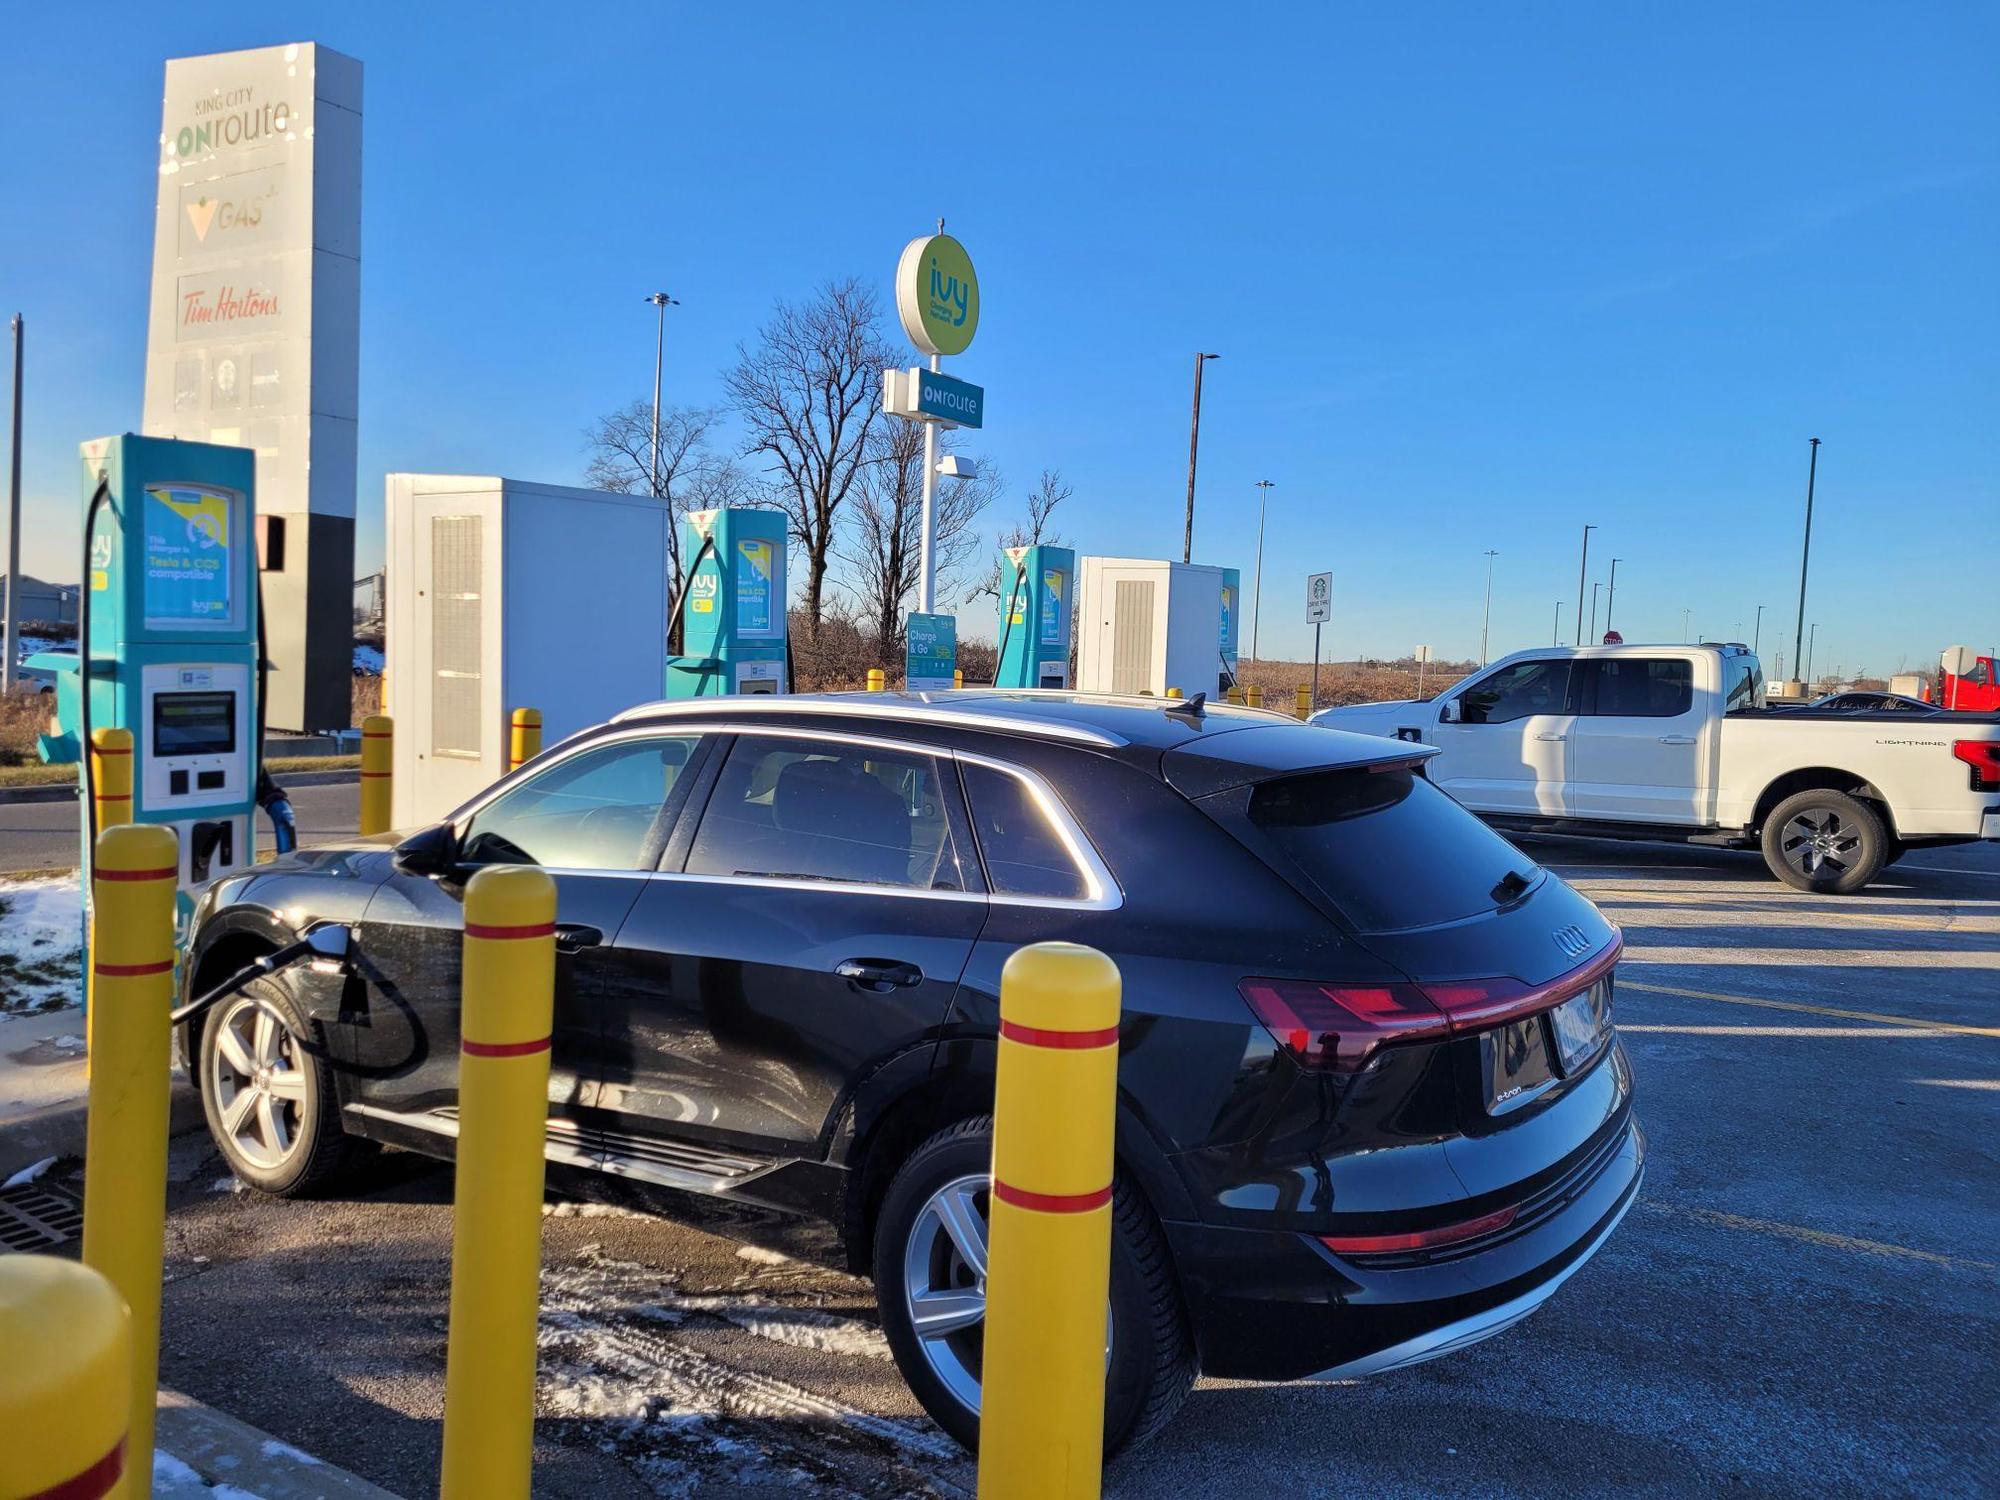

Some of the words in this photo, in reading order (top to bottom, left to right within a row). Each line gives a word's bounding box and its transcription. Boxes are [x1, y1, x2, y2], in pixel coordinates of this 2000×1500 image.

[195, 95, 223, 116] KING
[226, 87, 253, 107] CITY
[931, 257, 969, 327] ivy
[183, 290, 213, 326] Tim
[215, 286, 278, 322] Hortons
[148, 569, 214, 580] compatible
[910, 629, 937, 644] Charge
[910, 644, 917, 655] &
[917, 643, 928, 655] Go
[1876, 739, 1947, 747] LIGHTNING
[1496, 1086, 1521, 1103] e-tron
